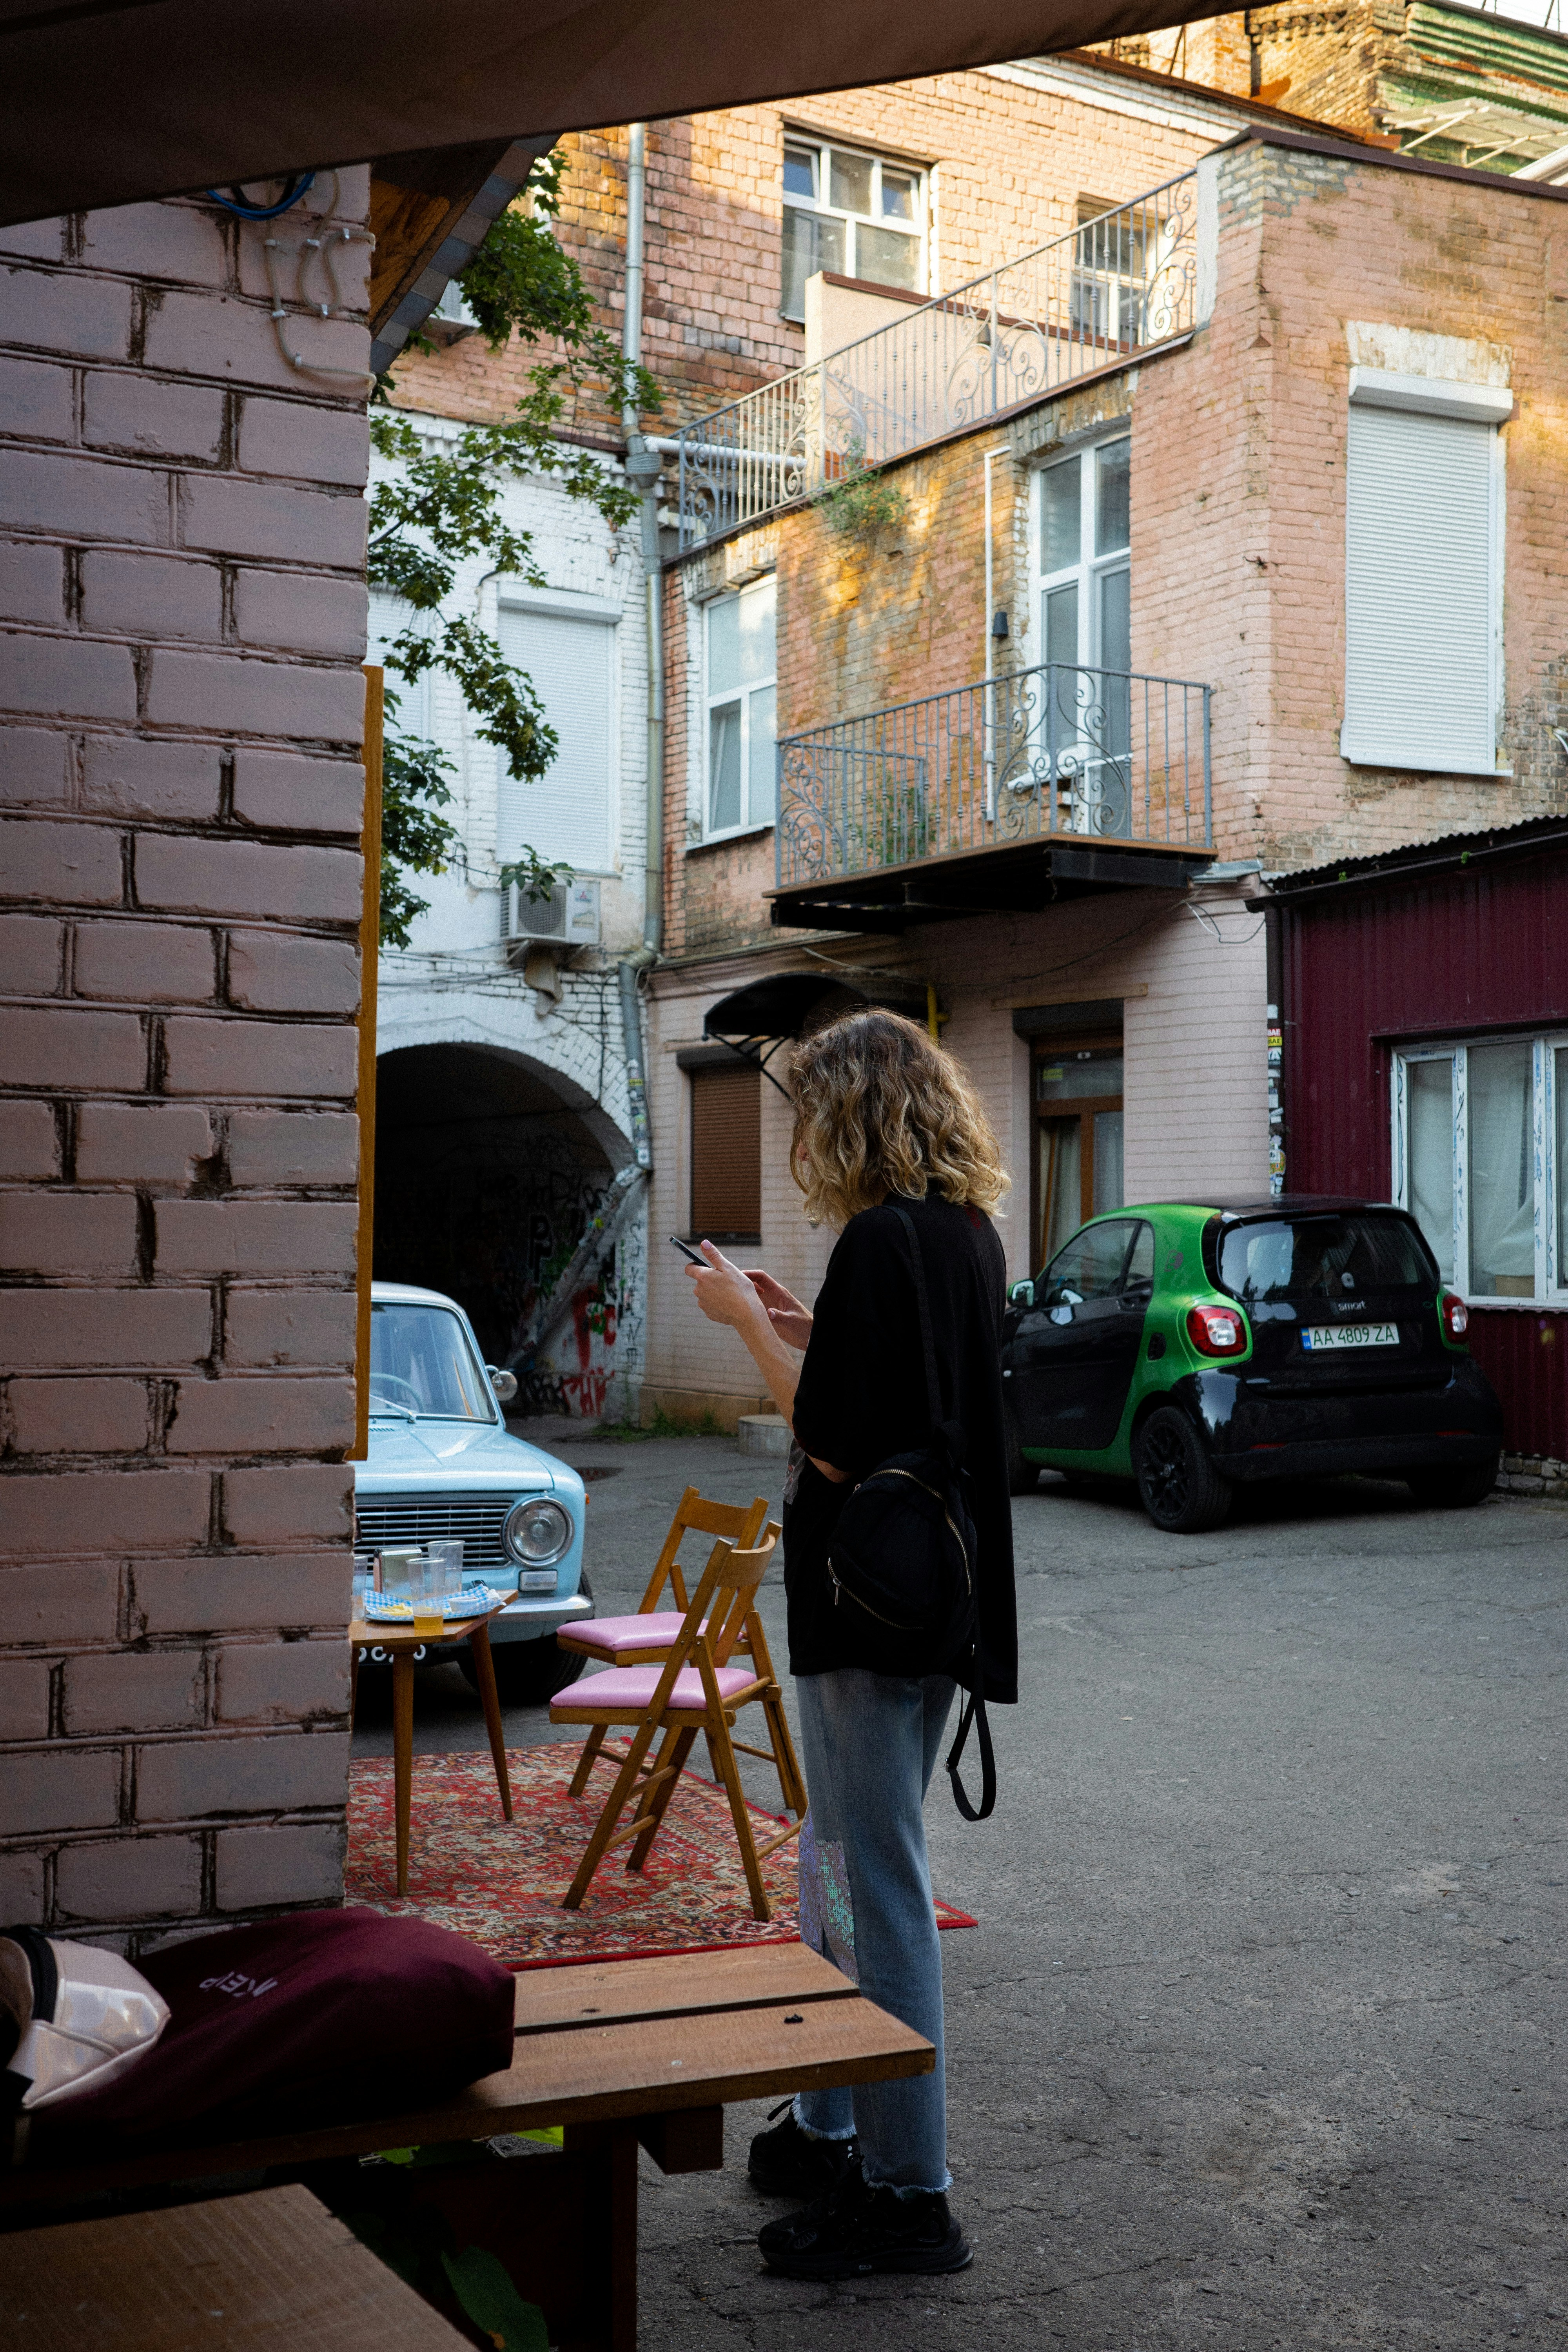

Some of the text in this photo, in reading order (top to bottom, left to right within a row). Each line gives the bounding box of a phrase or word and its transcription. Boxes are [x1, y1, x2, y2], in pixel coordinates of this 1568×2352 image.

[1338, 1300, 1366, 1311] smart
[1314, 1325, 1396, 1346] AA 4809 ZA
